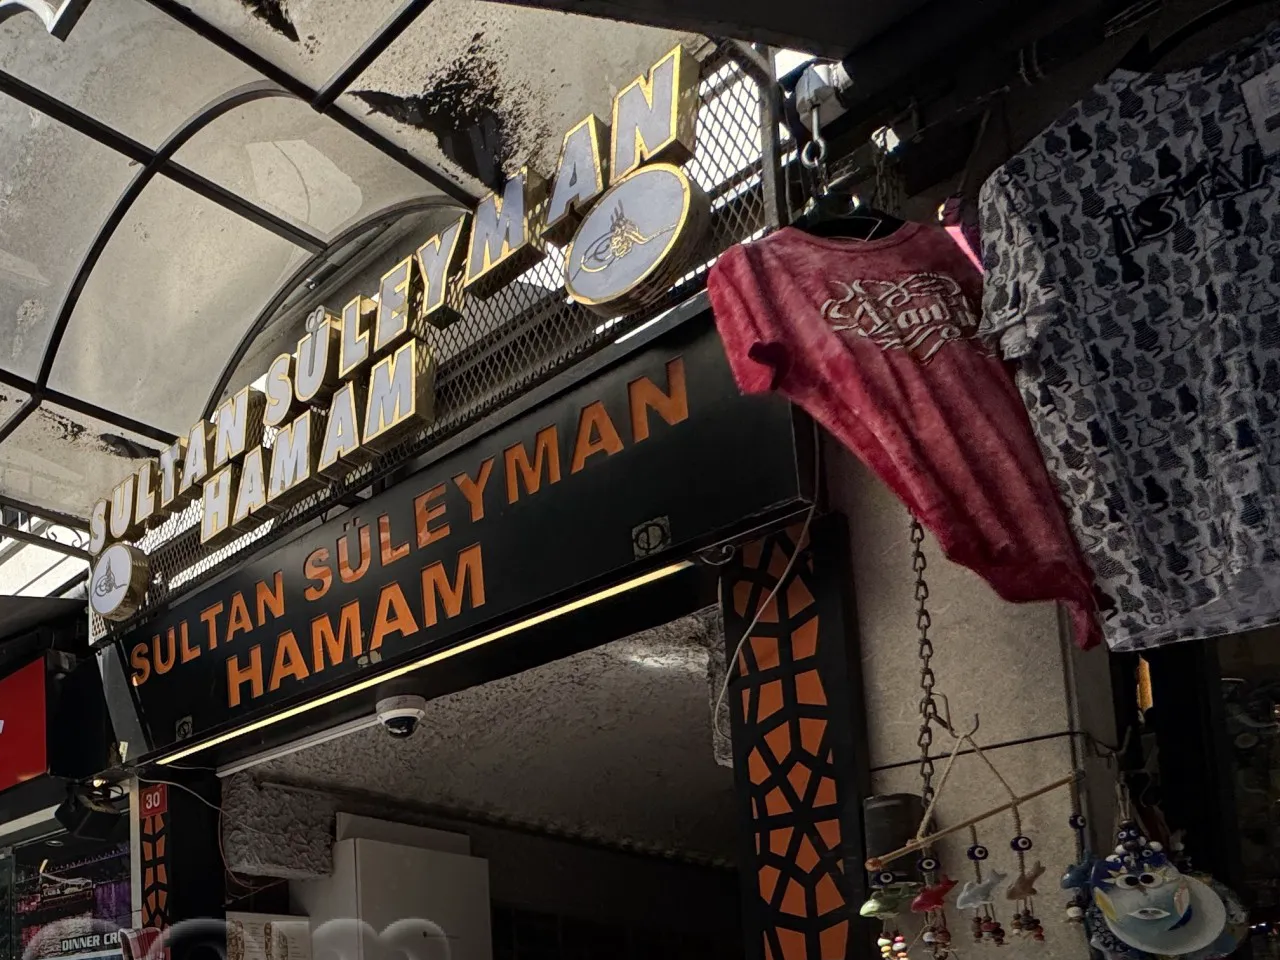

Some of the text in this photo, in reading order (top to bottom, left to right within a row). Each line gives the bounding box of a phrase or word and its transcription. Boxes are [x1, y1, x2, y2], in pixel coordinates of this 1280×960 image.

[89, 43, 682, 556] SULTAN SÜLEYMAN
[130, 355, 690, 687] SULTAN SÜLEYMAN
[200, 338, 417, 545] HAMAM
[225, 542, 486, 709] HAMAM
[145, 791, 160, 810] 30
[62, 934, 100, 951] DINNER
